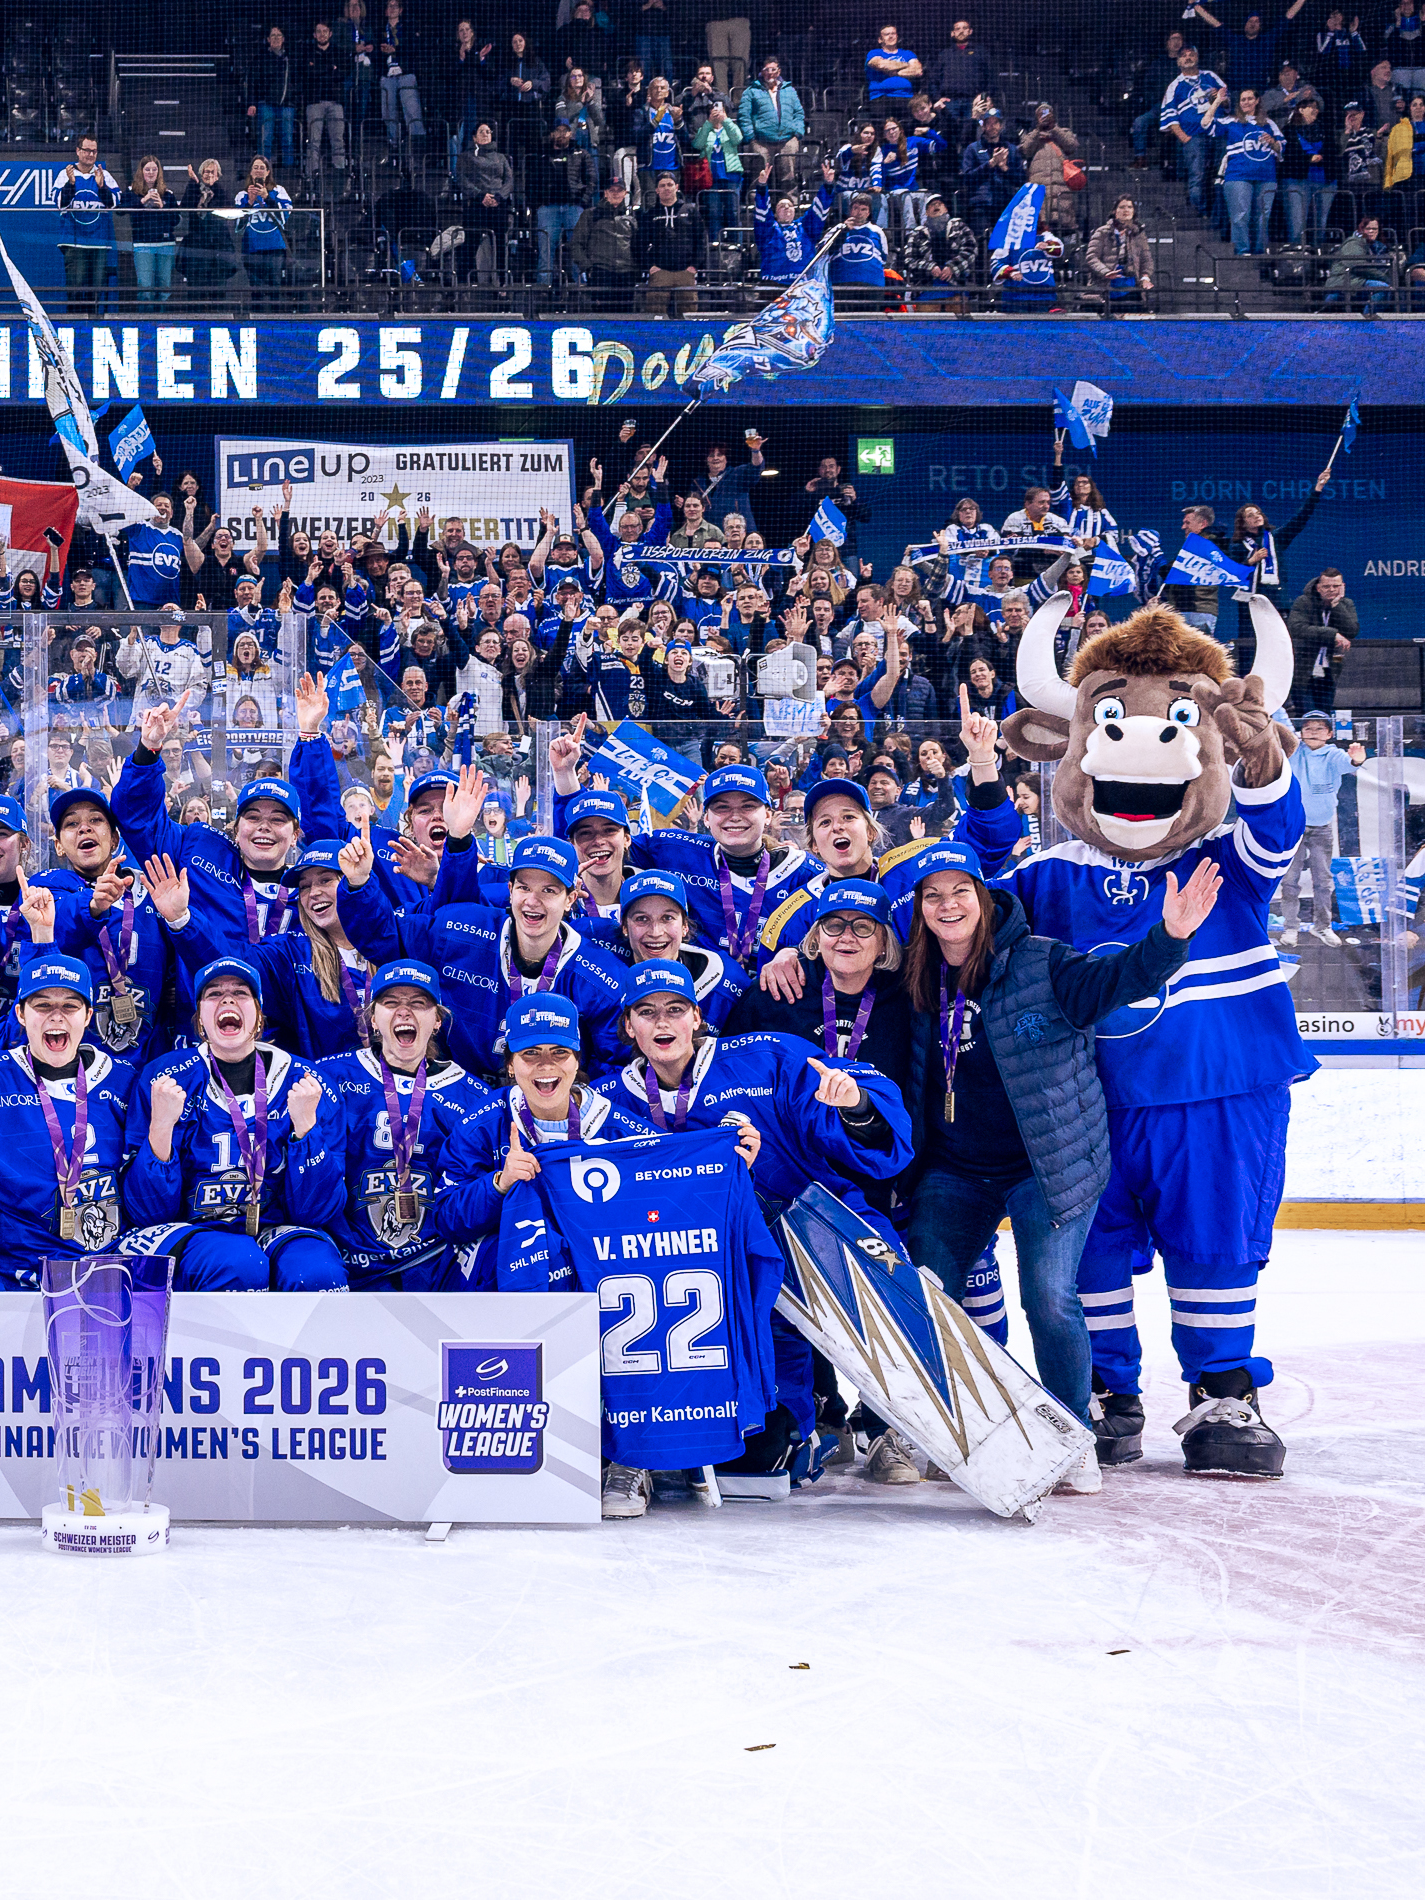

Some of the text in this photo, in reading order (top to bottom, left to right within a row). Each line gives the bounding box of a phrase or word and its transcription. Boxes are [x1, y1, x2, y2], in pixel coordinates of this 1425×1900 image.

[841, 241, 873, 254] EVZ
[1021, 259, 1048, 273] EVZ
[318, 327, 595, 399] 25/26
[396, 453, 563, 472] GRATULIERT ZUM
[361, 474, 384, 485] 2023
[928, 464, 1009, 491] RETO
[361, 492, 431, 502] 20 26
[154, 556, 180, 567] EVZ
[744, 548, 773, 560] ZUG
[630, 676, 645, 689] 23
[663, 690, 694, 706] CCM
[659, 831, 711, 848] BOSSARD
[768, 893, 806, 935] PostFinance
[445, 919, 498, 941] BOSSARD
[442, 965, 499, 993] GLENCORE
[575, 953, 620, 991] BOSSARD
[1018, 1013, 1043, 1029] EVZ
[293, 1060, 339, 1104] BOSSARD
[71, 1122, 99, 1164] 2
[635, 1163, 724, 1182] BEYOND RED
[592, 1227, 719, 1261] V. RYHNER
[342, 1247, 386, 1269] Zuger
[509, 1257, 529, 1273] SHL
[597, 1269, 728, 1376] 22
[243, 1357, 387, 1415] 2026
[468, 1387, 530, 1397] PostFinance
[439, 1403, 549, 1431] WOMEN'S
[272, 1427, 387, 1461] LEAGUE
[447, 1431, 535, 1458] LEAGUE
[53, 1532, 137, 1546] SCHWEIZER MEISTER
[58, 1545, 132, 1553] POSTFINANCE WOMEN'S LEAGUE
